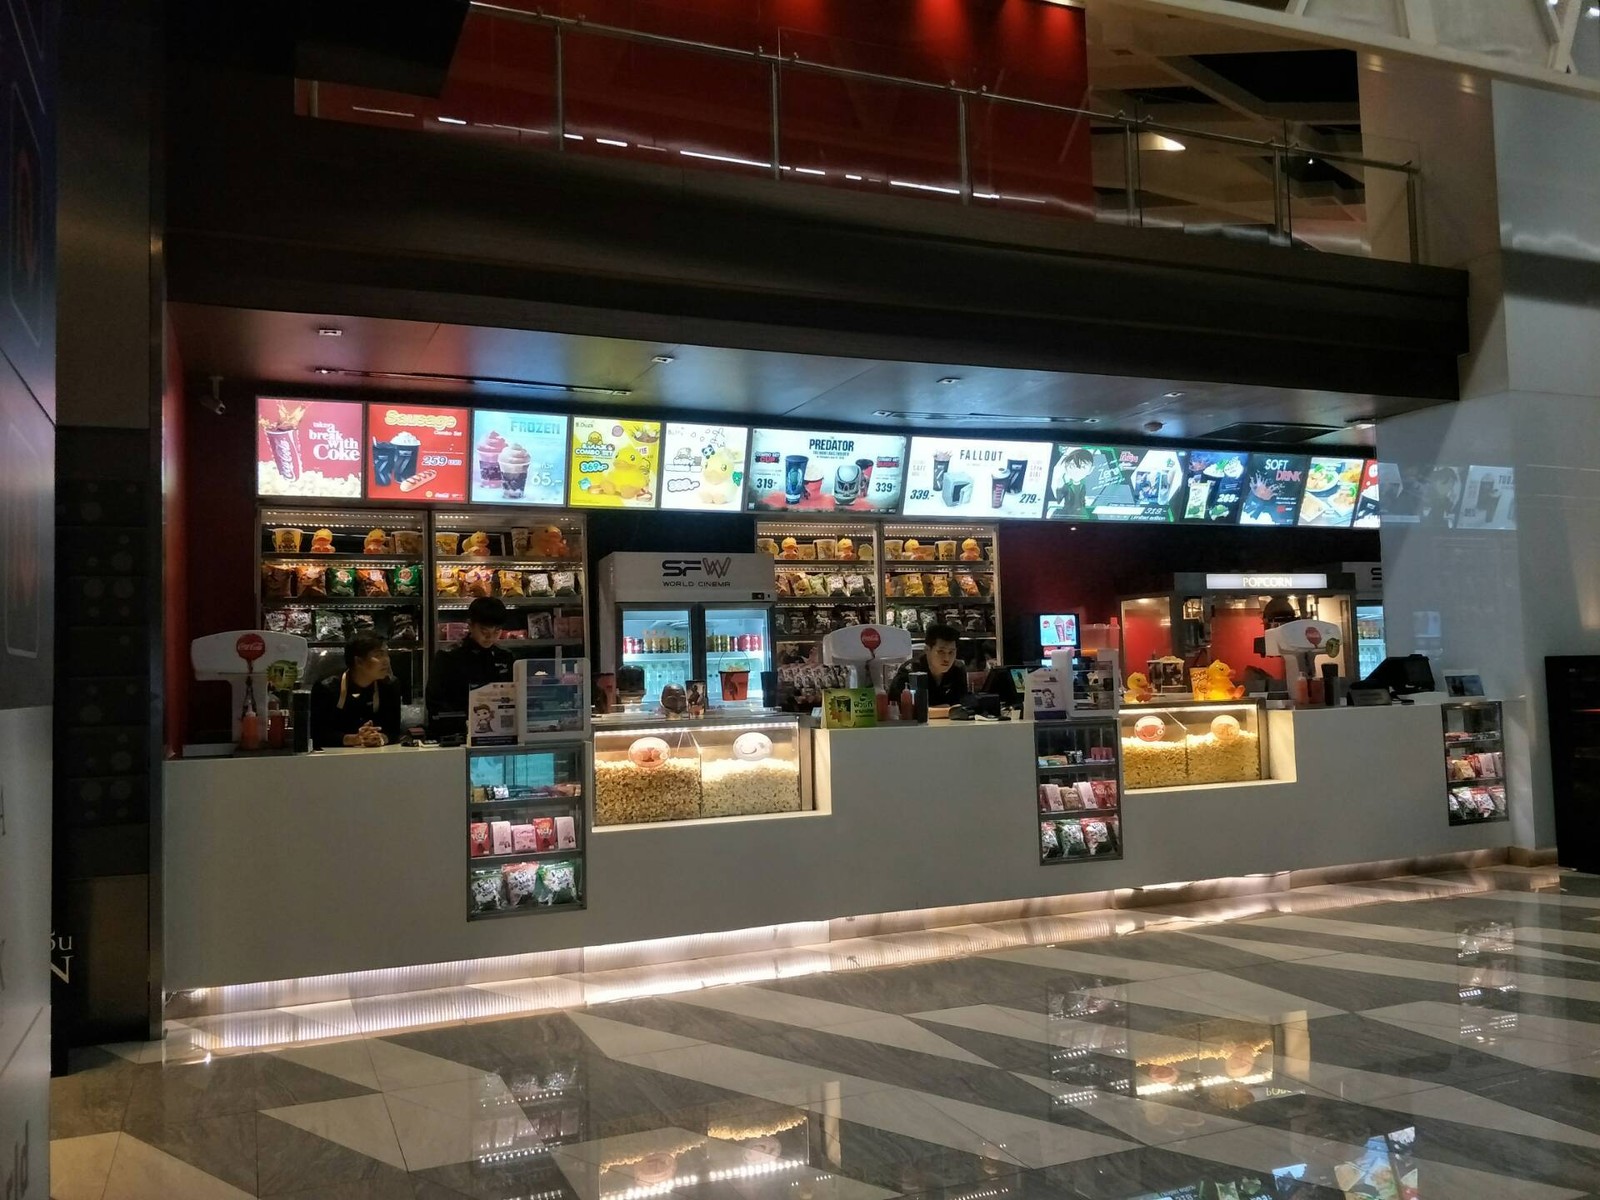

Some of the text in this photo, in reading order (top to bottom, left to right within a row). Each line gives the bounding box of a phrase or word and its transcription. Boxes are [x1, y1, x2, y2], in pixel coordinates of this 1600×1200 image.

[511, 421, 560, 434] FROZEN
[308, 429, 342, 441] break
[328, 437, 359, 450] with
[808, 438, 855, 452] PREDATOR
[313, 443, 361, 461] Coke
[960, 449, 1003, 461] FALLOUT
[422, 456, 447, 466] 259
[1265, 459, 1289, 470] SOFT
[1275, 470, 1302, 482] DRINK
[1242, 577, 1293, 587] POPCORN
